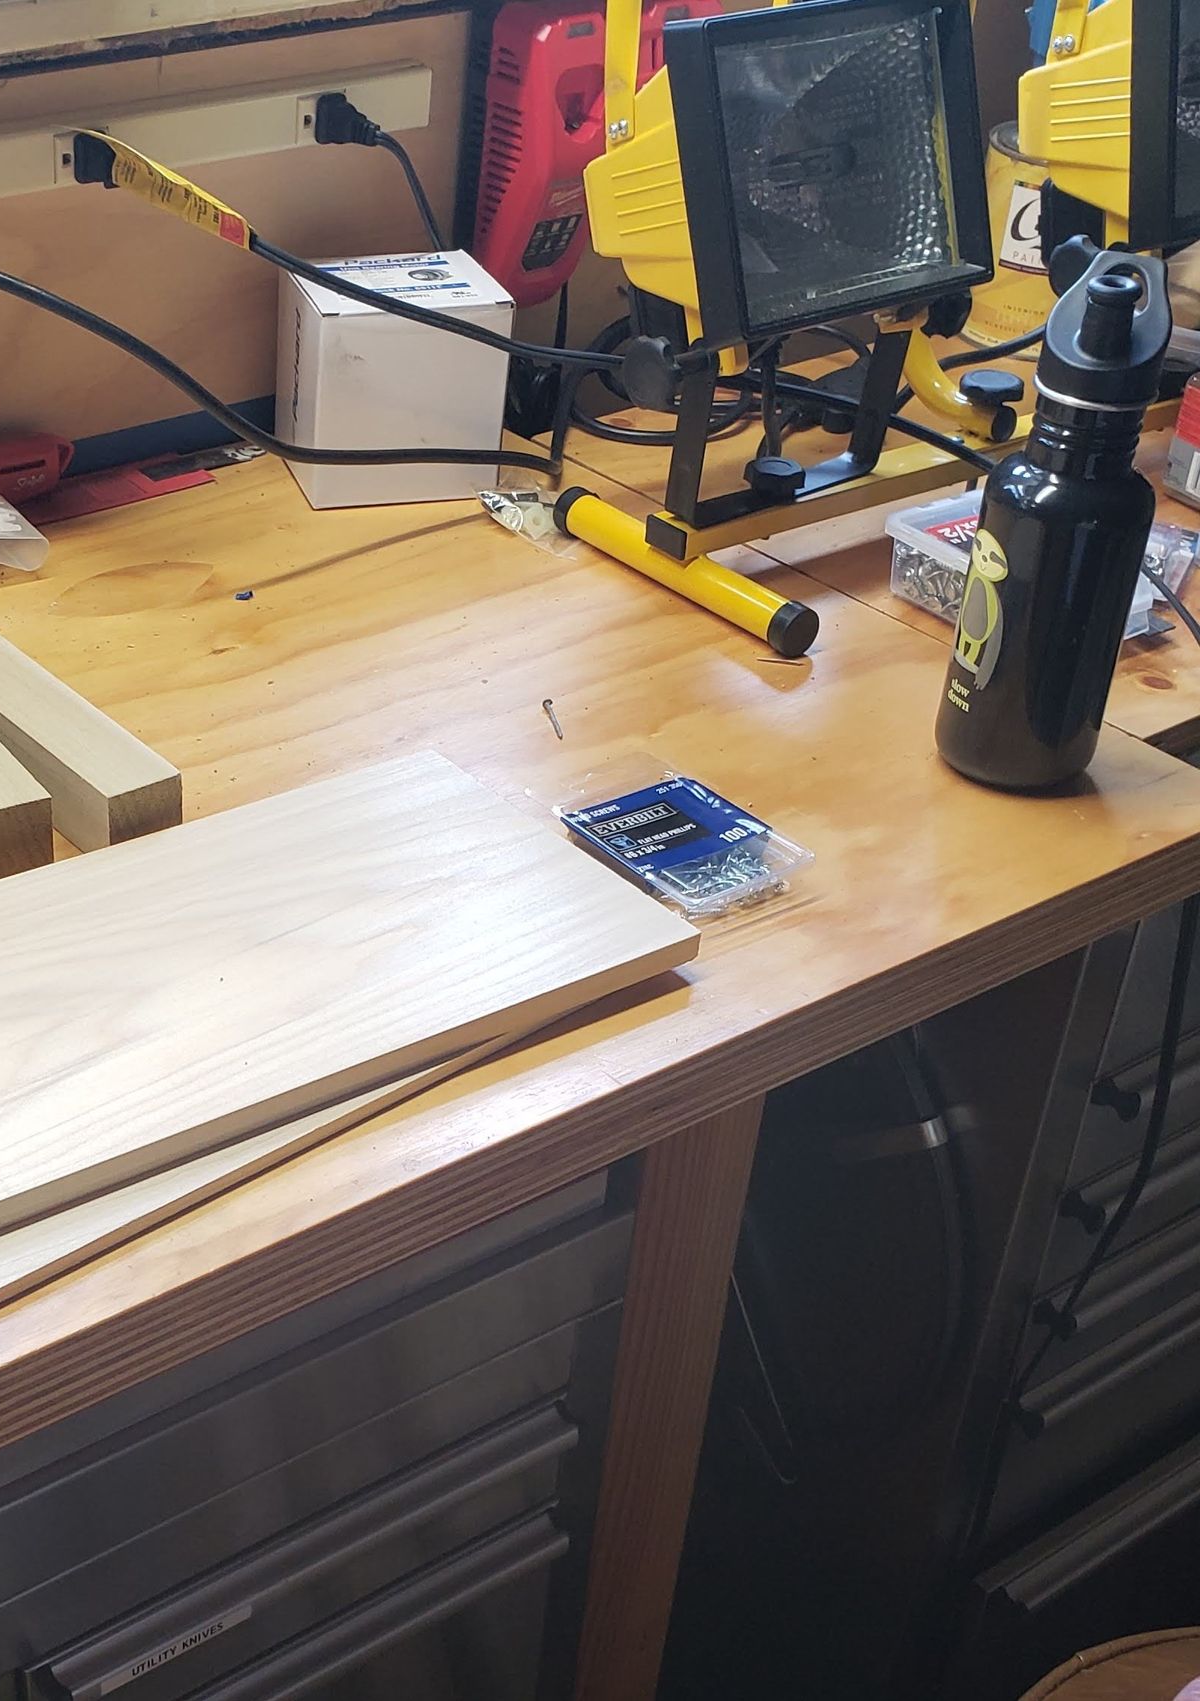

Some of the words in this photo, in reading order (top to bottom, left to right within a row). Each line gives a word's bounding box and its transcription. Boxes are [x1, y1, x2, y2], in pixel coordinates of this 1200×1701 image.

[344, 254, 441, 265] Packard
[951, 678, 970, 698] slow
[947, 688, 970, 713] down
[589, 805, 620, 818] SCREWS
[593, 806, 669, 835] EVERBILT
[637, 835, 653, 845] FLAT
[668, 823, 697, 838] PHILLIPS
[718, 827, 747, 843] 100
[131, 1646, 177, 1677] UTILITY
[182, 1622, 224, 1650] KNIVES
